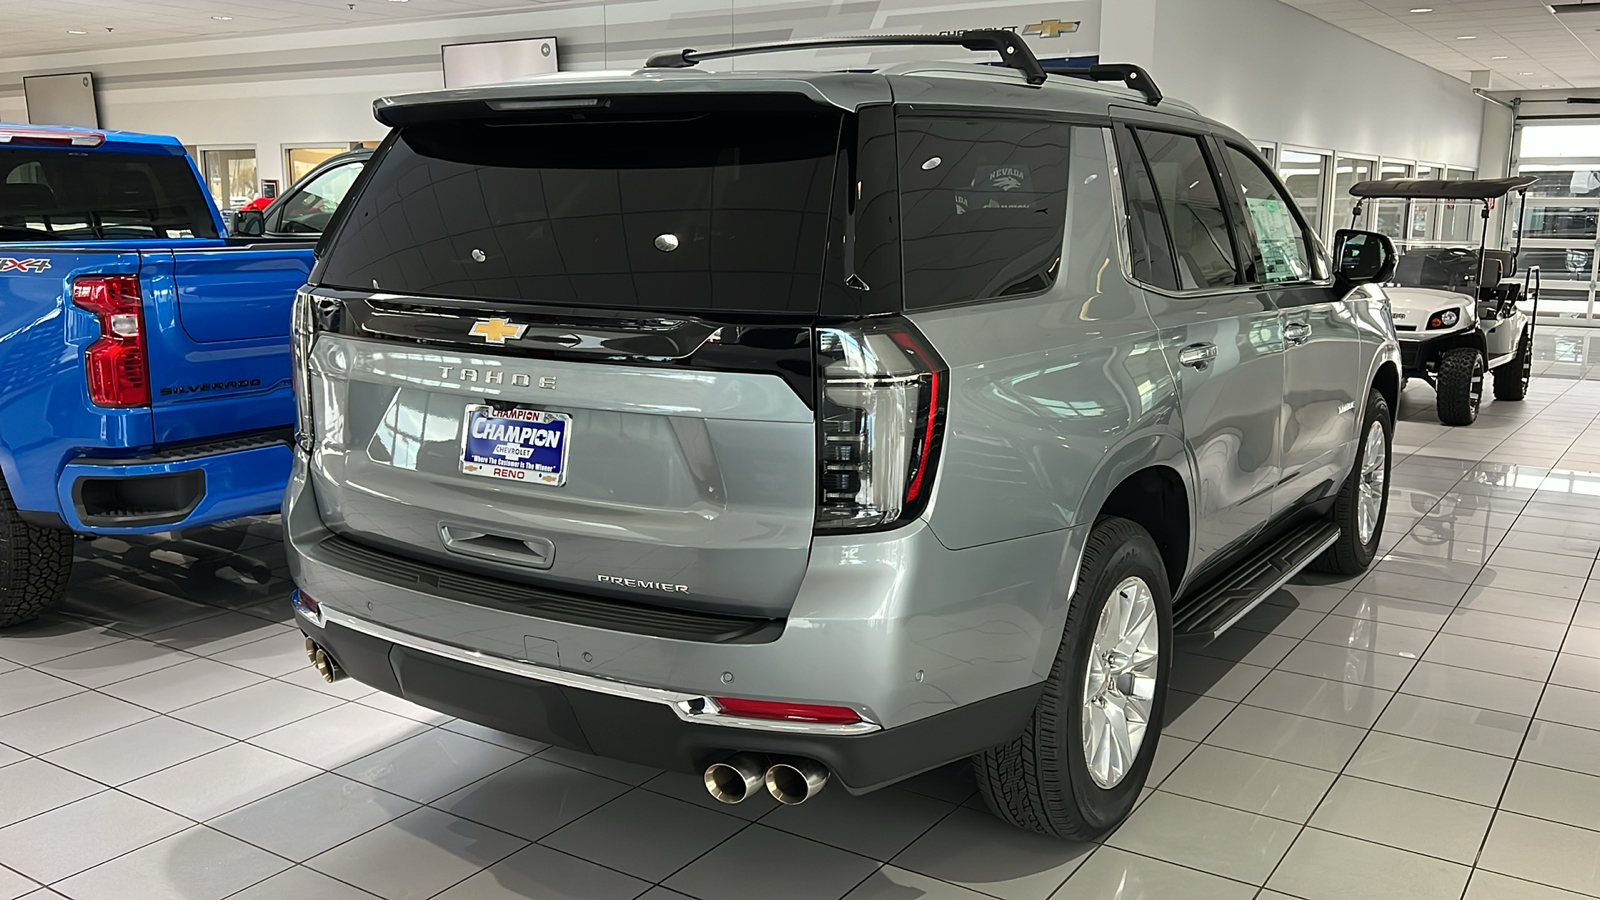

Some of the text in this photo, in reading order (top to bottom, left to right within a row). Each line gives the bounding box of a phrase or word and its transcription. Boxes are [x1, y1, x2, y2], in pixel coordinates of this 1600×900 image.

[989, 168, 1024, 180] NEVADA
[438, 366, 557, 390] TAHOE
[160, 379, 262, 396] SILVERADO
[492, 409, 540, 421] CHAMPION
[472, 418, 560, 448] CHAMPION
[496, 446, 531, 456] CHEVROLET
[525, 462, 535, 470] The
[493, 468, 525, 479] RENO
[597, 574, 690, 595] PREMIER
